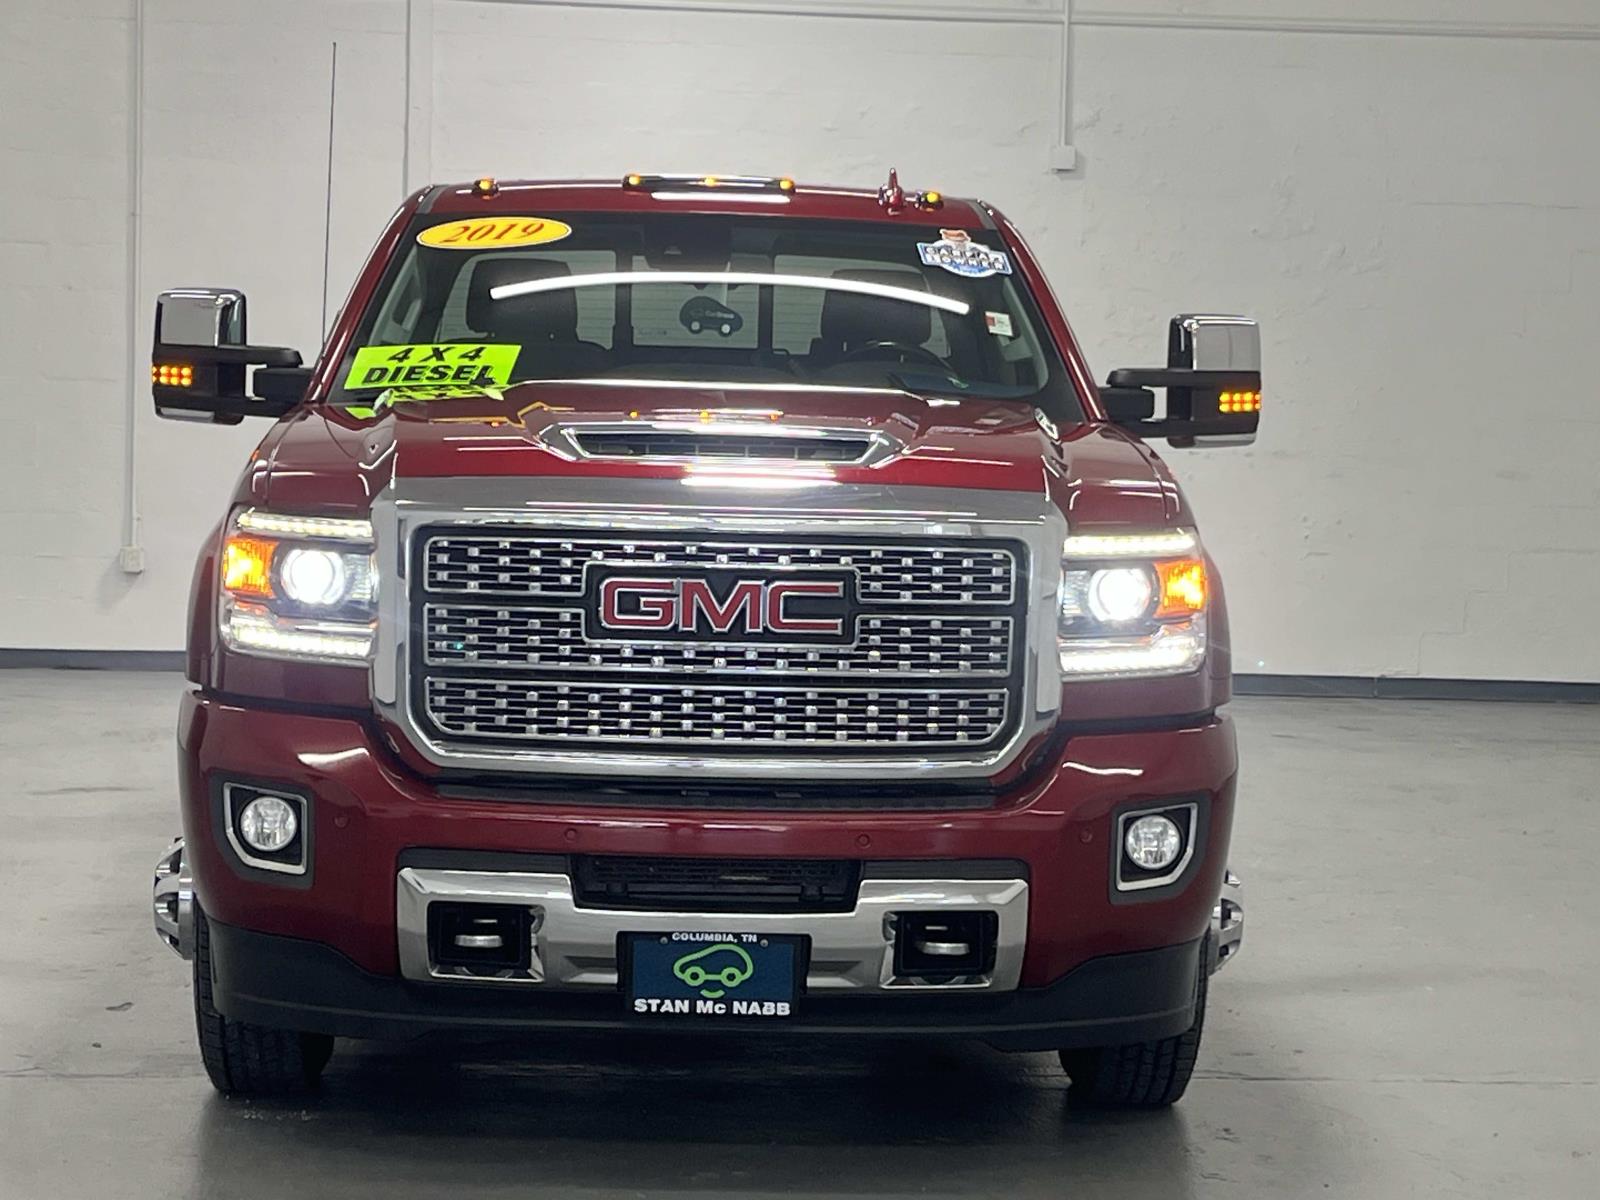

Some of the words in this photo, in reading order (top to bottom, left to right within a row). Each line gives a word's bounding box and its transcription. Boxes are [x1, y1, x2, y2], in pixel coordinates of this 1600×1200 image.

[439, 222, 545, 243] 2019
[361, 364, 495, 385] DIESEL
[600, 577, 844, 635] GMC
[741, 933, 757, 943] TN
[634, 998, 690, 1013] STAN
[696, 1000, 726, 1014] Mc
[733, 1001, 791, 1015] NABB
